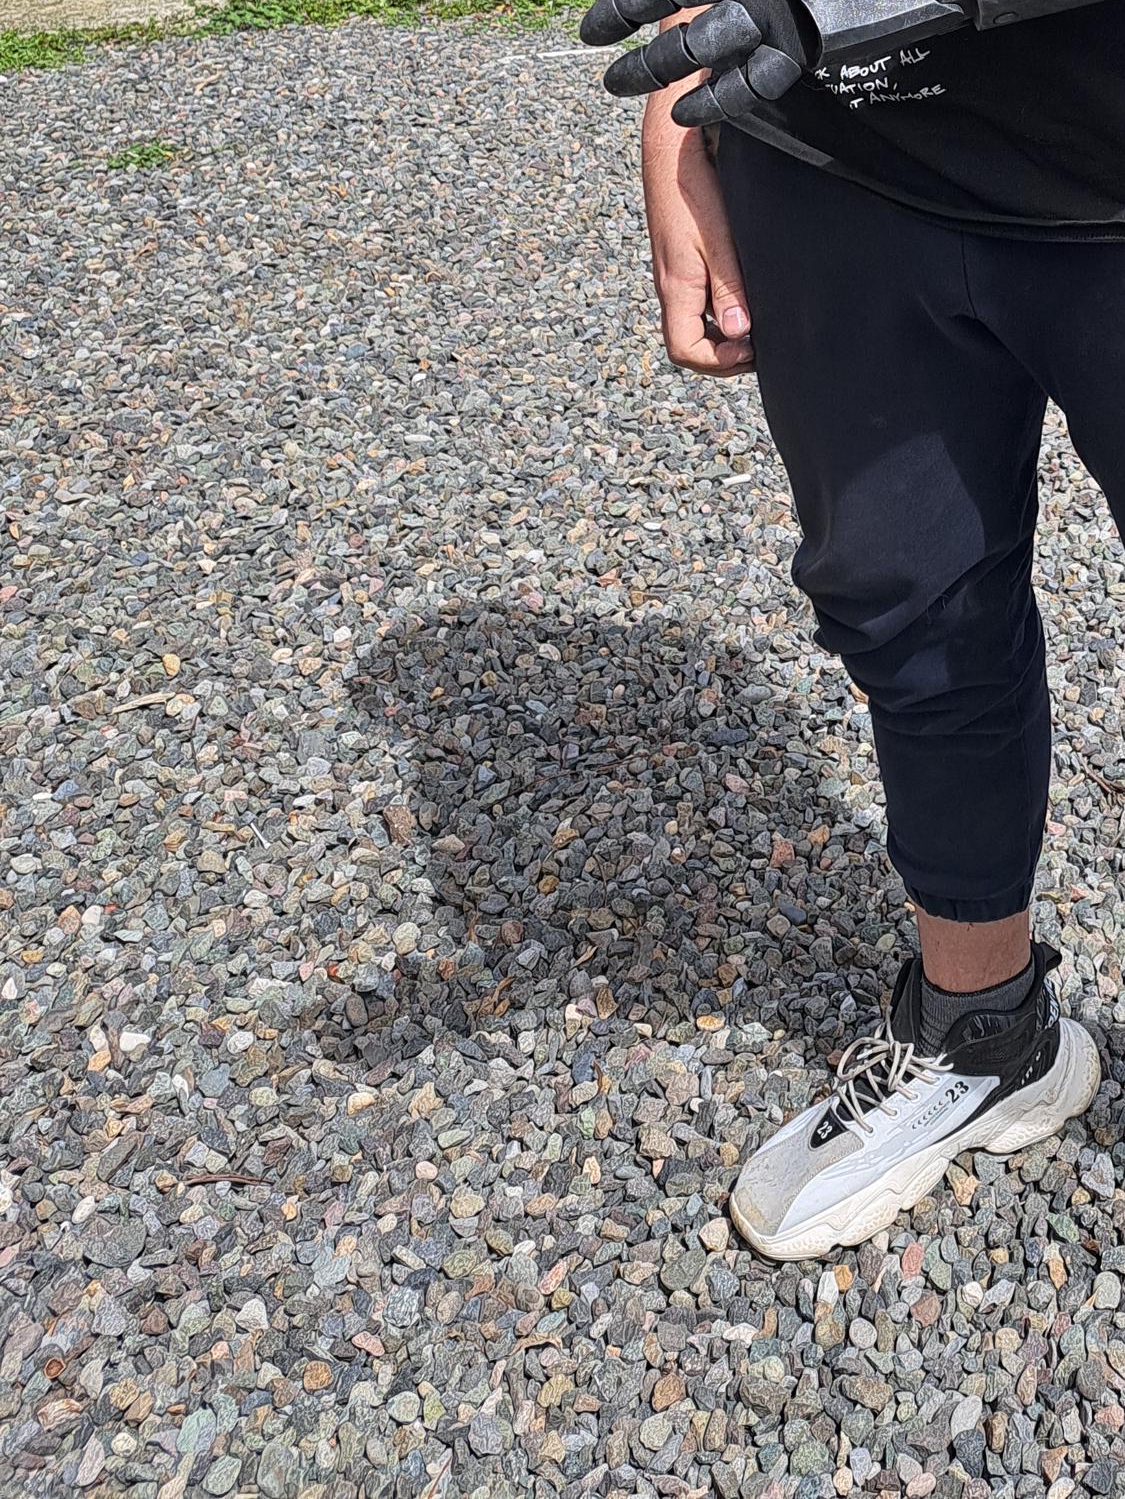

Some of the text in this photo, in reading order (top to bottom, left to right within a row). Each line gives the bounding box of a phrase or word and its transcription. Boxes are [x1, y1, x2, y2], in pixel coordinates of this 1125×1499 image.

[840, 56, 892, 80] ABOUT
[900, 48, 931, 66] ALL
[825, 77, 898, 95] UATION,
[869, 84, 947, 104] ANYMORE
[945, 1081, 969, 1103] 23
[816, 1121, 833, 1139] 23
